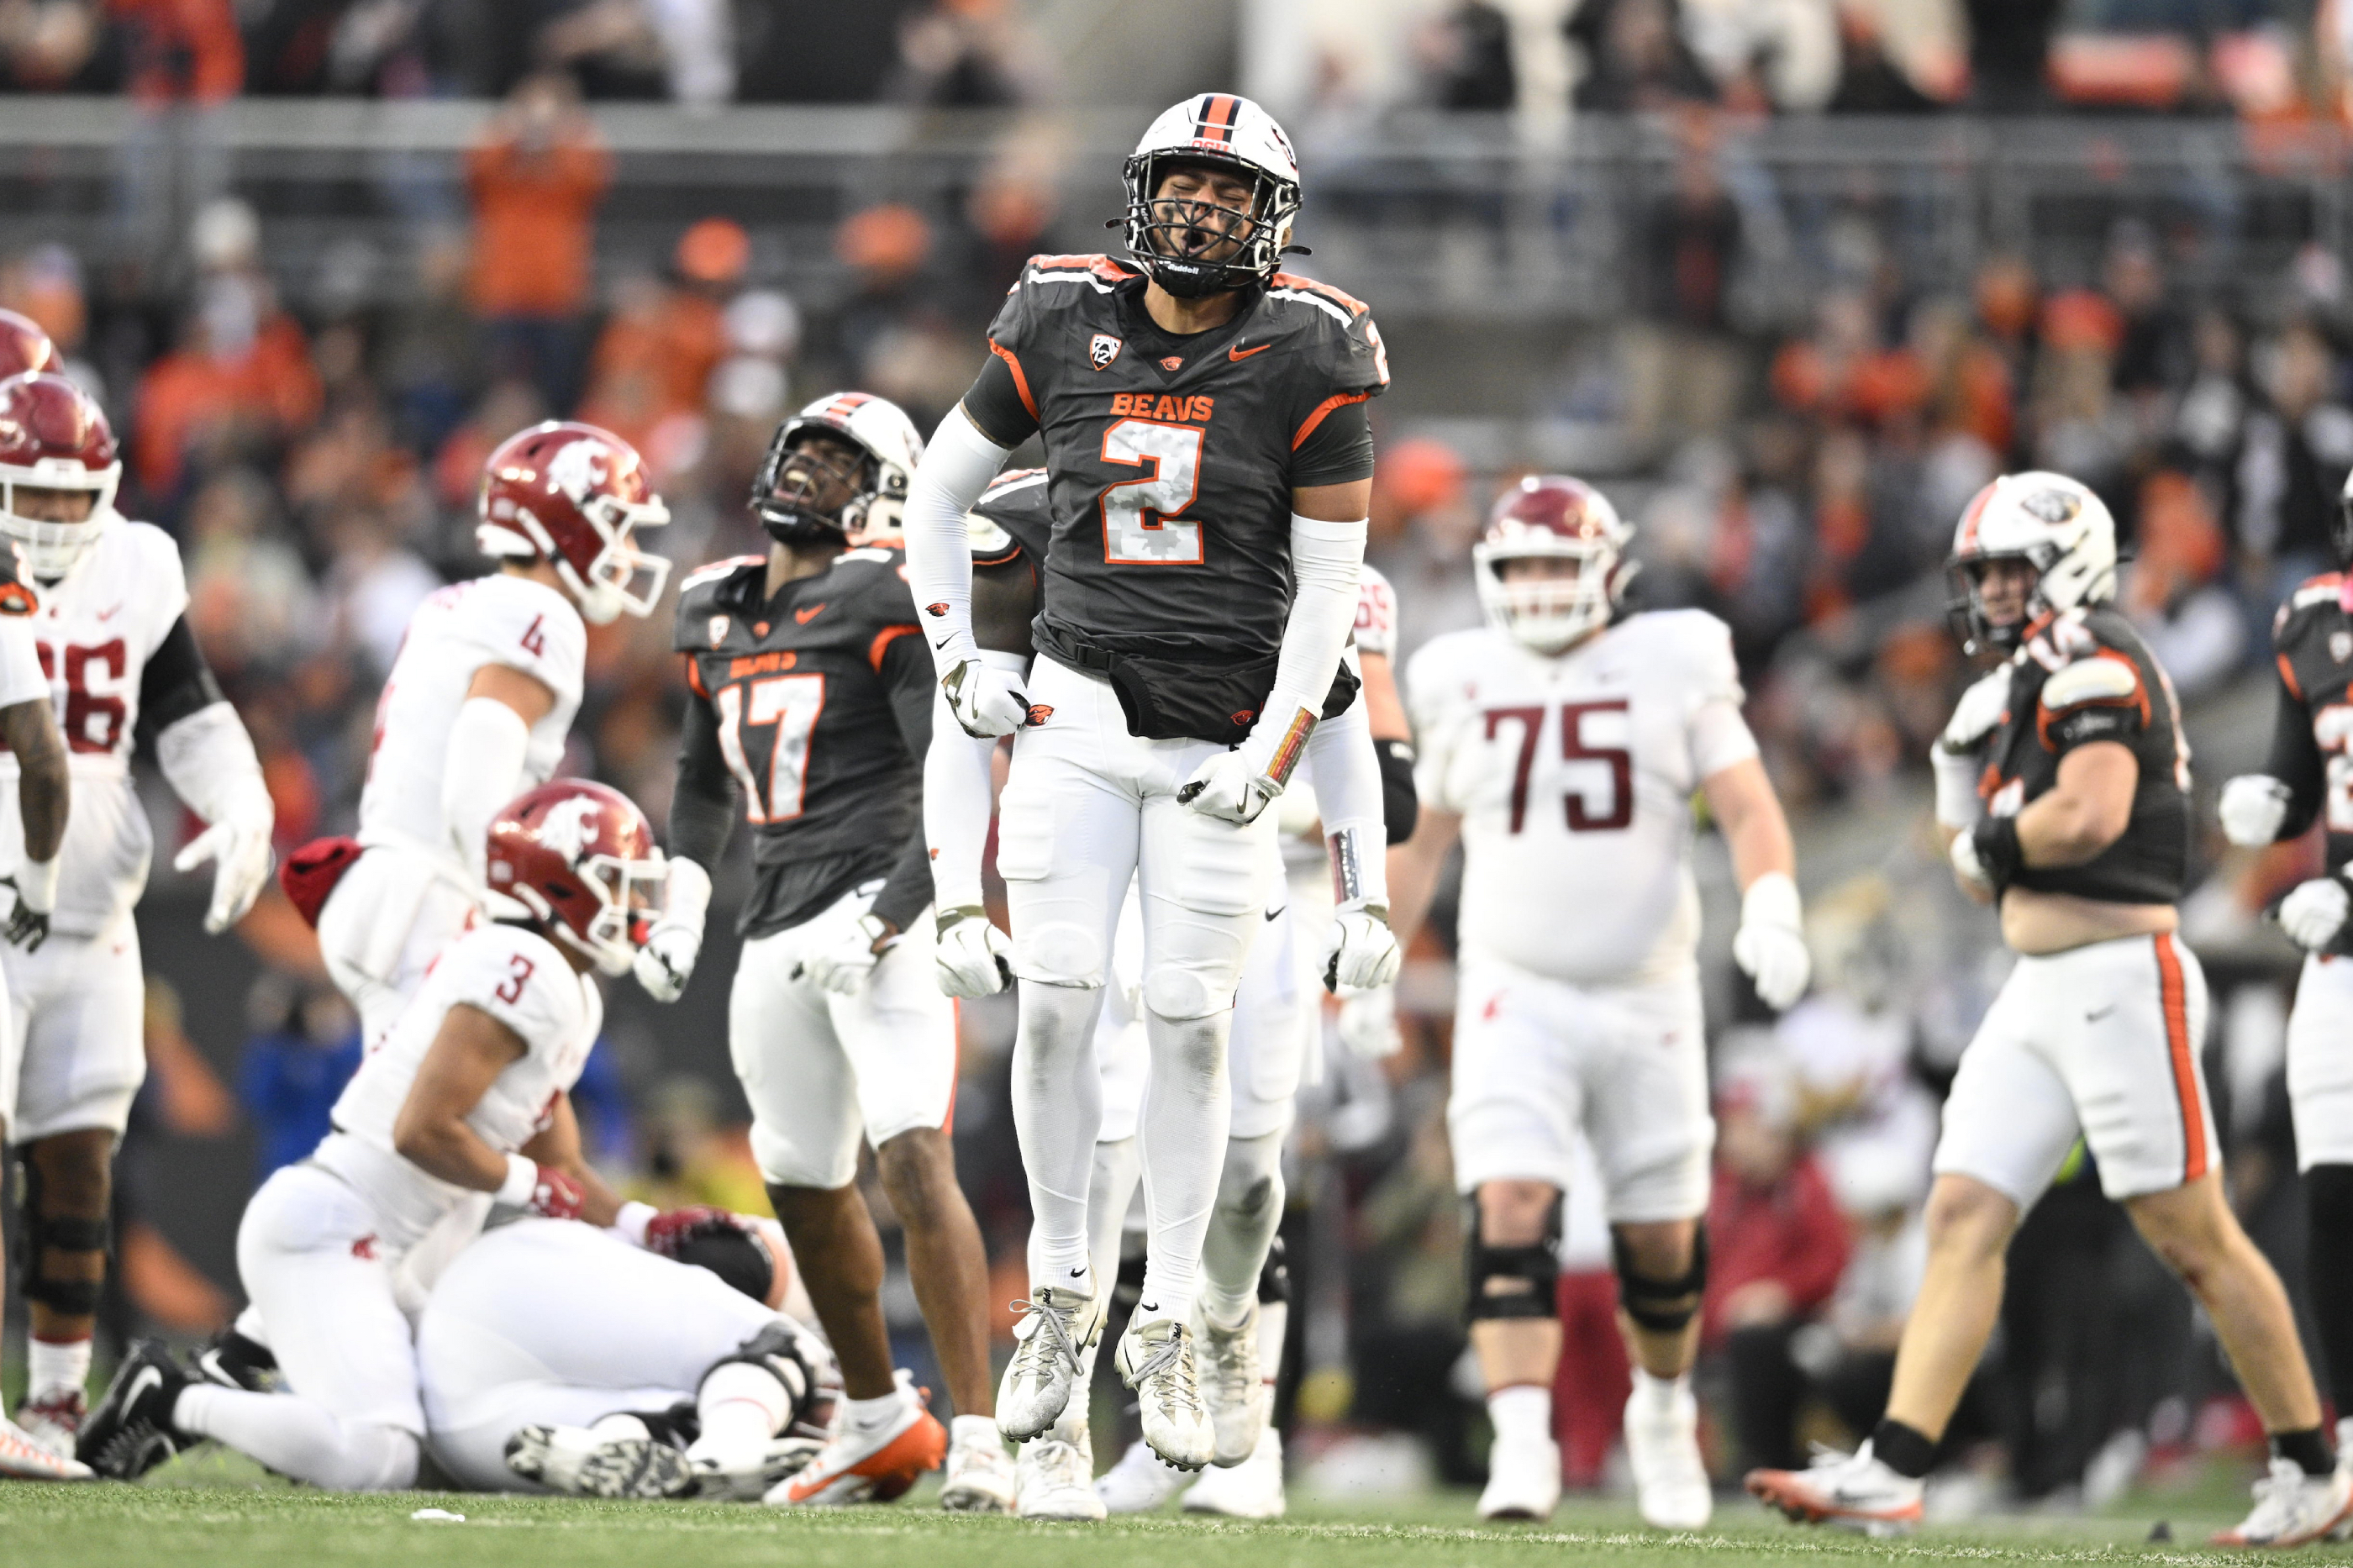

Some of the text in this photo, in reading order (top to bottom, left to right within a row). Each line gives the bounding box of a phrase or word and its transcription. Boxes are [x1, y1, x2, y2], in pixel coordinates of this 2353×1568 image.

[1168, 263, 1199, 275] Riddell
[1092, 335, 1120, 360] PAC
[1093, 350, 1110, 364] 12
[1109, 392, 1214, 421] BEAVS
[1098, 417, 1205, 566] 2
[519, 612, 545, 659] 4
[718, 672, 825, 825] 17
[1482, 699, 1634, 835] 75
[496, 953, 534, 1006] 3
